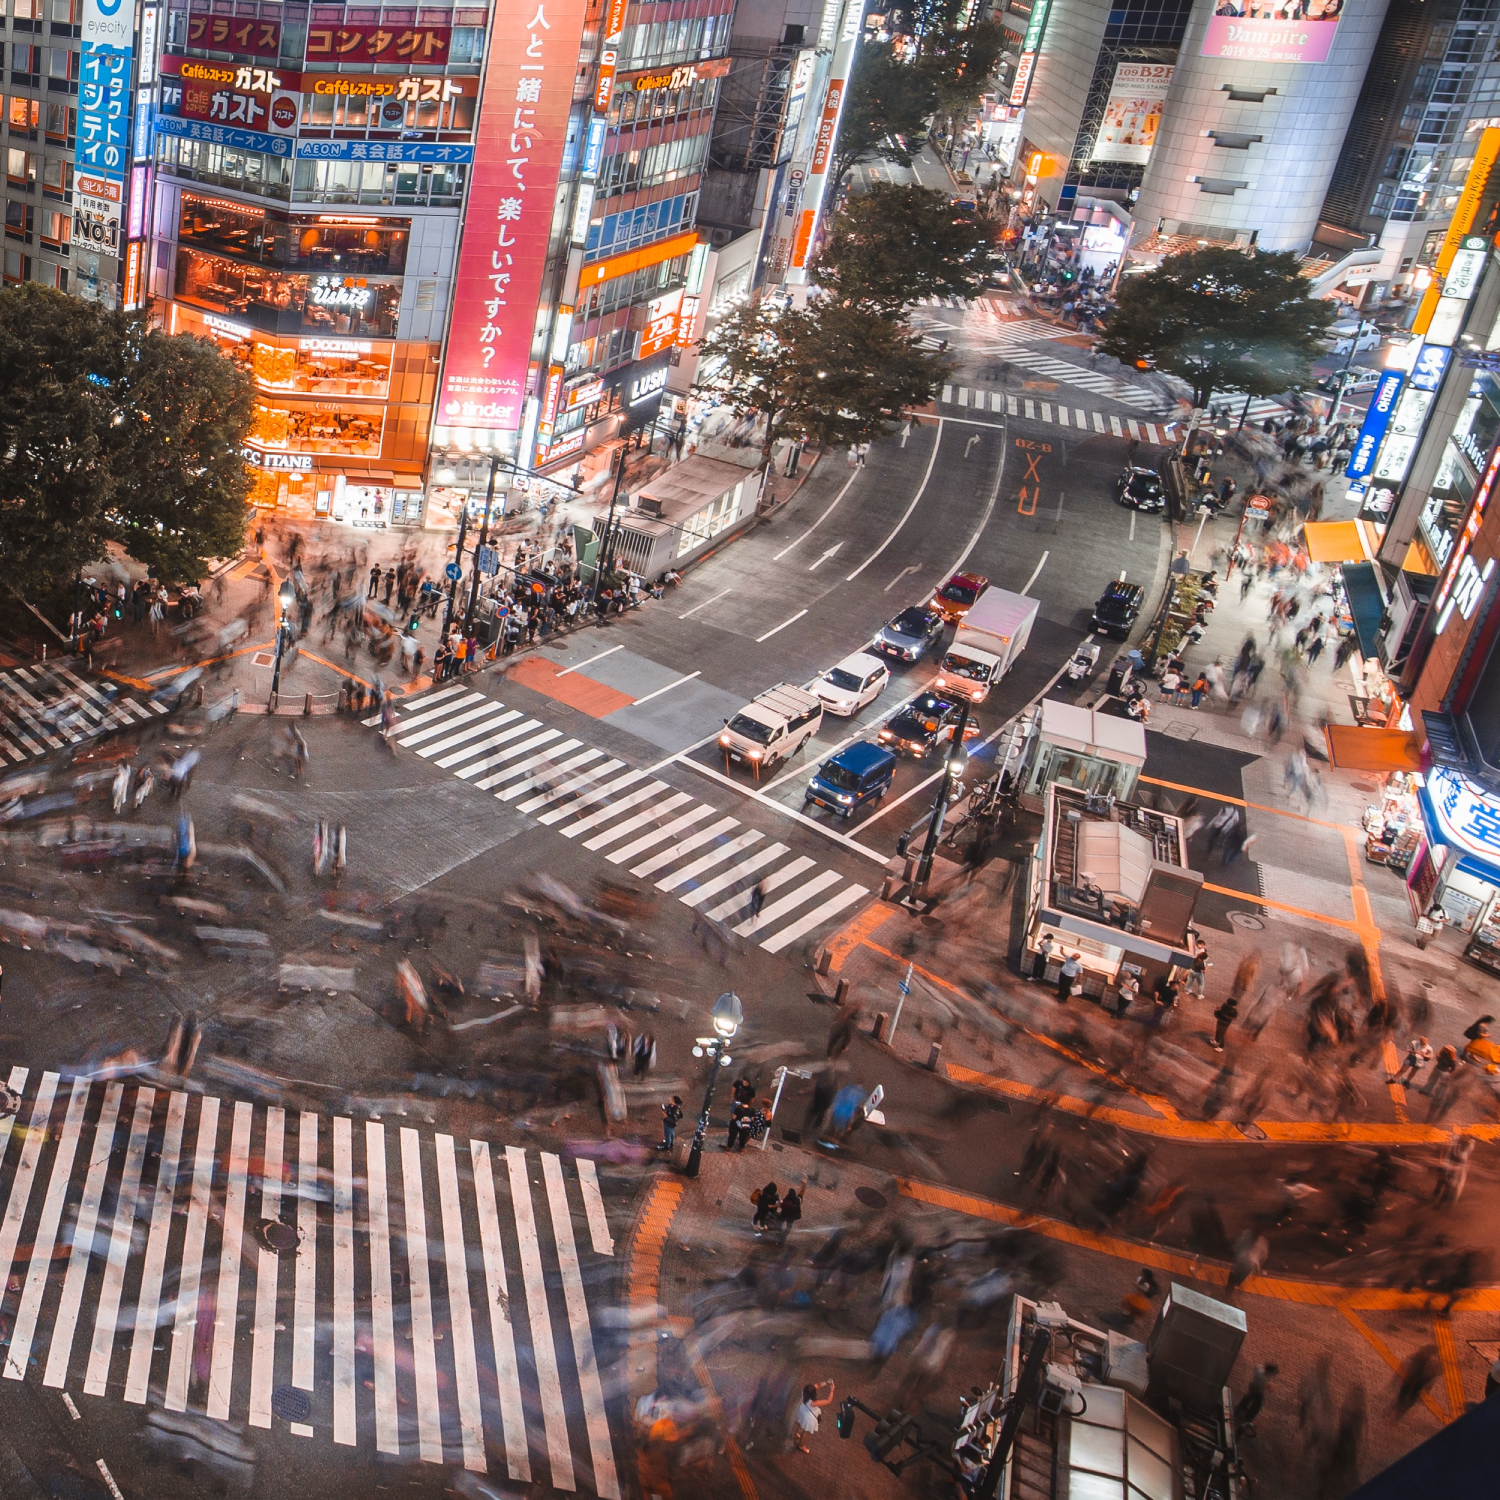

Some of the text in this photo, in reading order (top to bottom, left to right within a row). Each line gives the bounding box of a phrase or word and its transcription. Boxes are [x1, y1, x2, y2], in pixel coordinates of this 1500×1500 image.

[87, 20, 128, 38] eyecity
[190, 18, 276, 49] プライス
[1227, 25, 1309, 46] Vampire
[307, 30, 445, 57] コンタクト
[1220, 45, 1271, 58] 2019.9.25
[1284, 52, 1304, 61] SALE
[236, 67, 281, 94] ガスト
[669, 66, 697, 89] ガスト
[1011, 58, 1032, 101] HOOTERS
[1119, 68, 1139, 77] 109
[163, 86, 182, 105] 7F
[186, 90, 209, 105] Café
[397, 77, 463, 102] ガスト
[210, 92, 264, 123] ガスト
[275, 110, 293, 120] ガスト
[159, 118, 287, 152] AEON 英会話イーオン 6F
[815, 117, 835, 165] TaxFree
[303, 143, 469, 160] AEON 英会話イーオン
[82, 197, 111, 213] 利用者数
[74, 207, 119, 249] No.1
[203, 314, 251, 338] L'OCCITANE
[300, 339, 372, 353] L'OCCITANE
[632, 366, 668, 400] LUSH
[1376, 377, 1400, 412] MIZUHO
[462, 400, 515, 418] tinder
